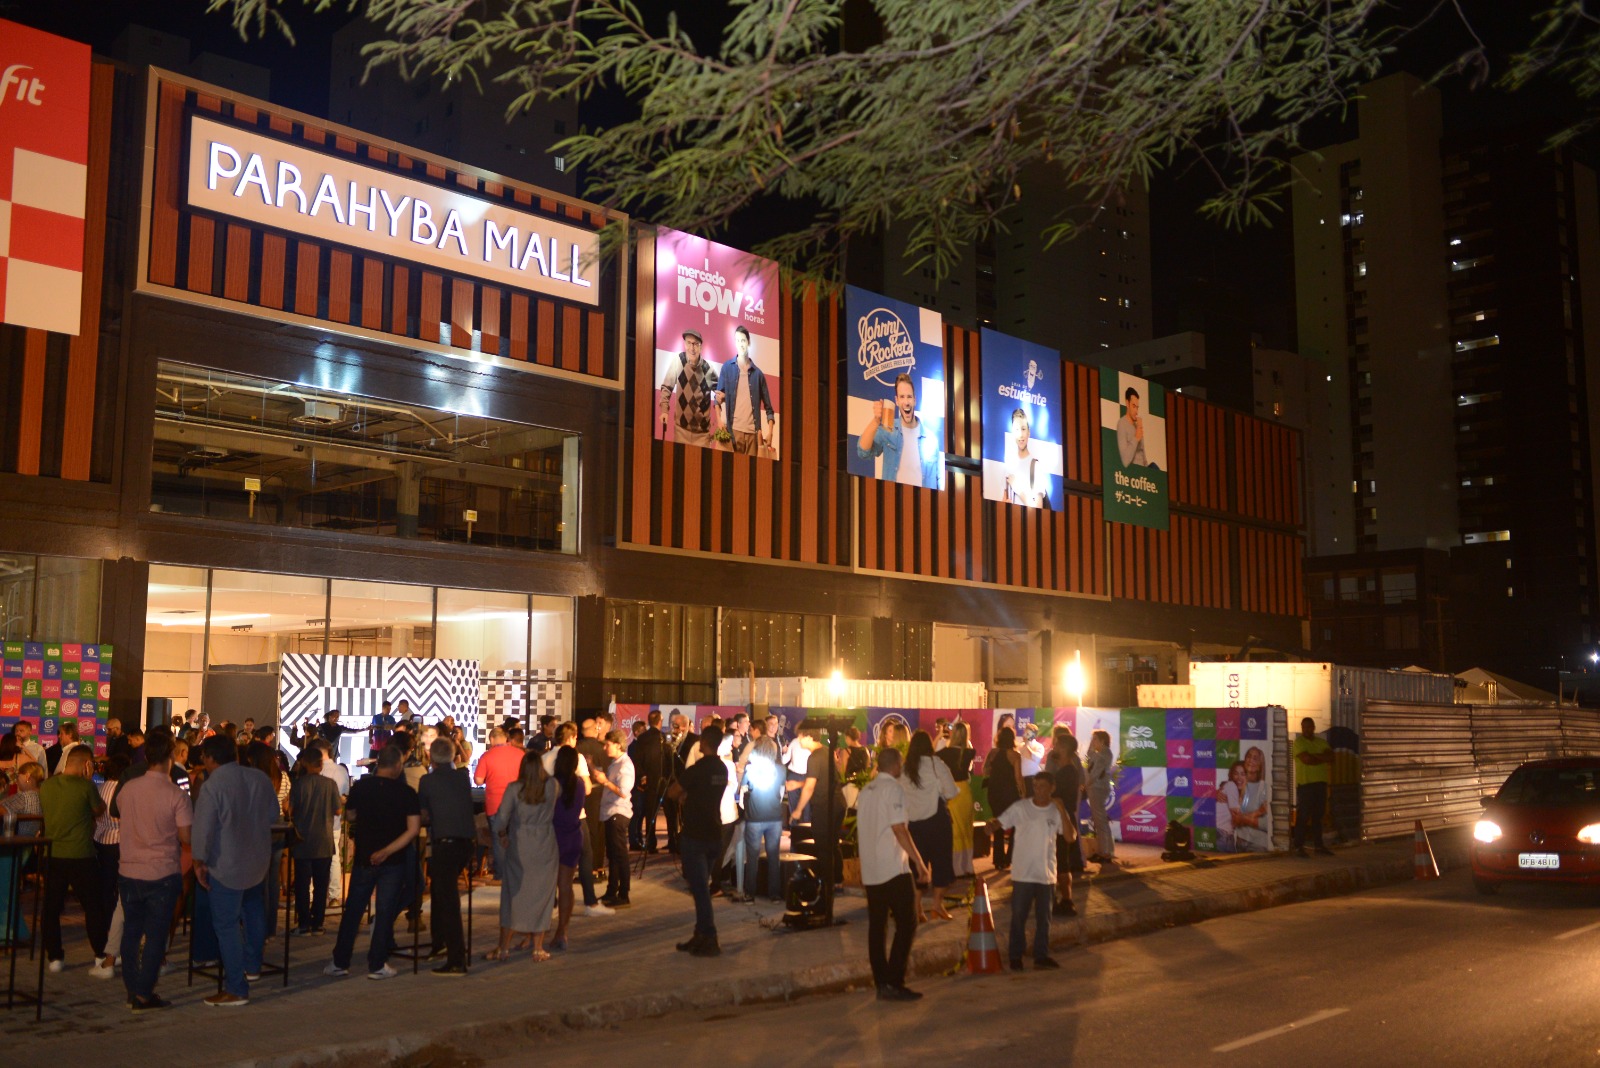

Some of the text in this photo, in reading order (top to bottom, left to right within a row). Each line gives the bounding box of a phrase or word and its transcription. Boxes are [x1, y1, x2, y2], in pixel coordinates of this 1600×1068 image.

[207, 141, 592, 288] PARAHYBA MALL
[677, 264, 726, 287] mercado
[677, 274, 764, 318] now 24
[744, 312, 765, 325] horas
[858, 316, 905, 366] Johnny
[866, 336, 913, 368] Rockets
[998, 384, 1047, 407] estudante
[1114, 470, 1158, 494] the coffee.
